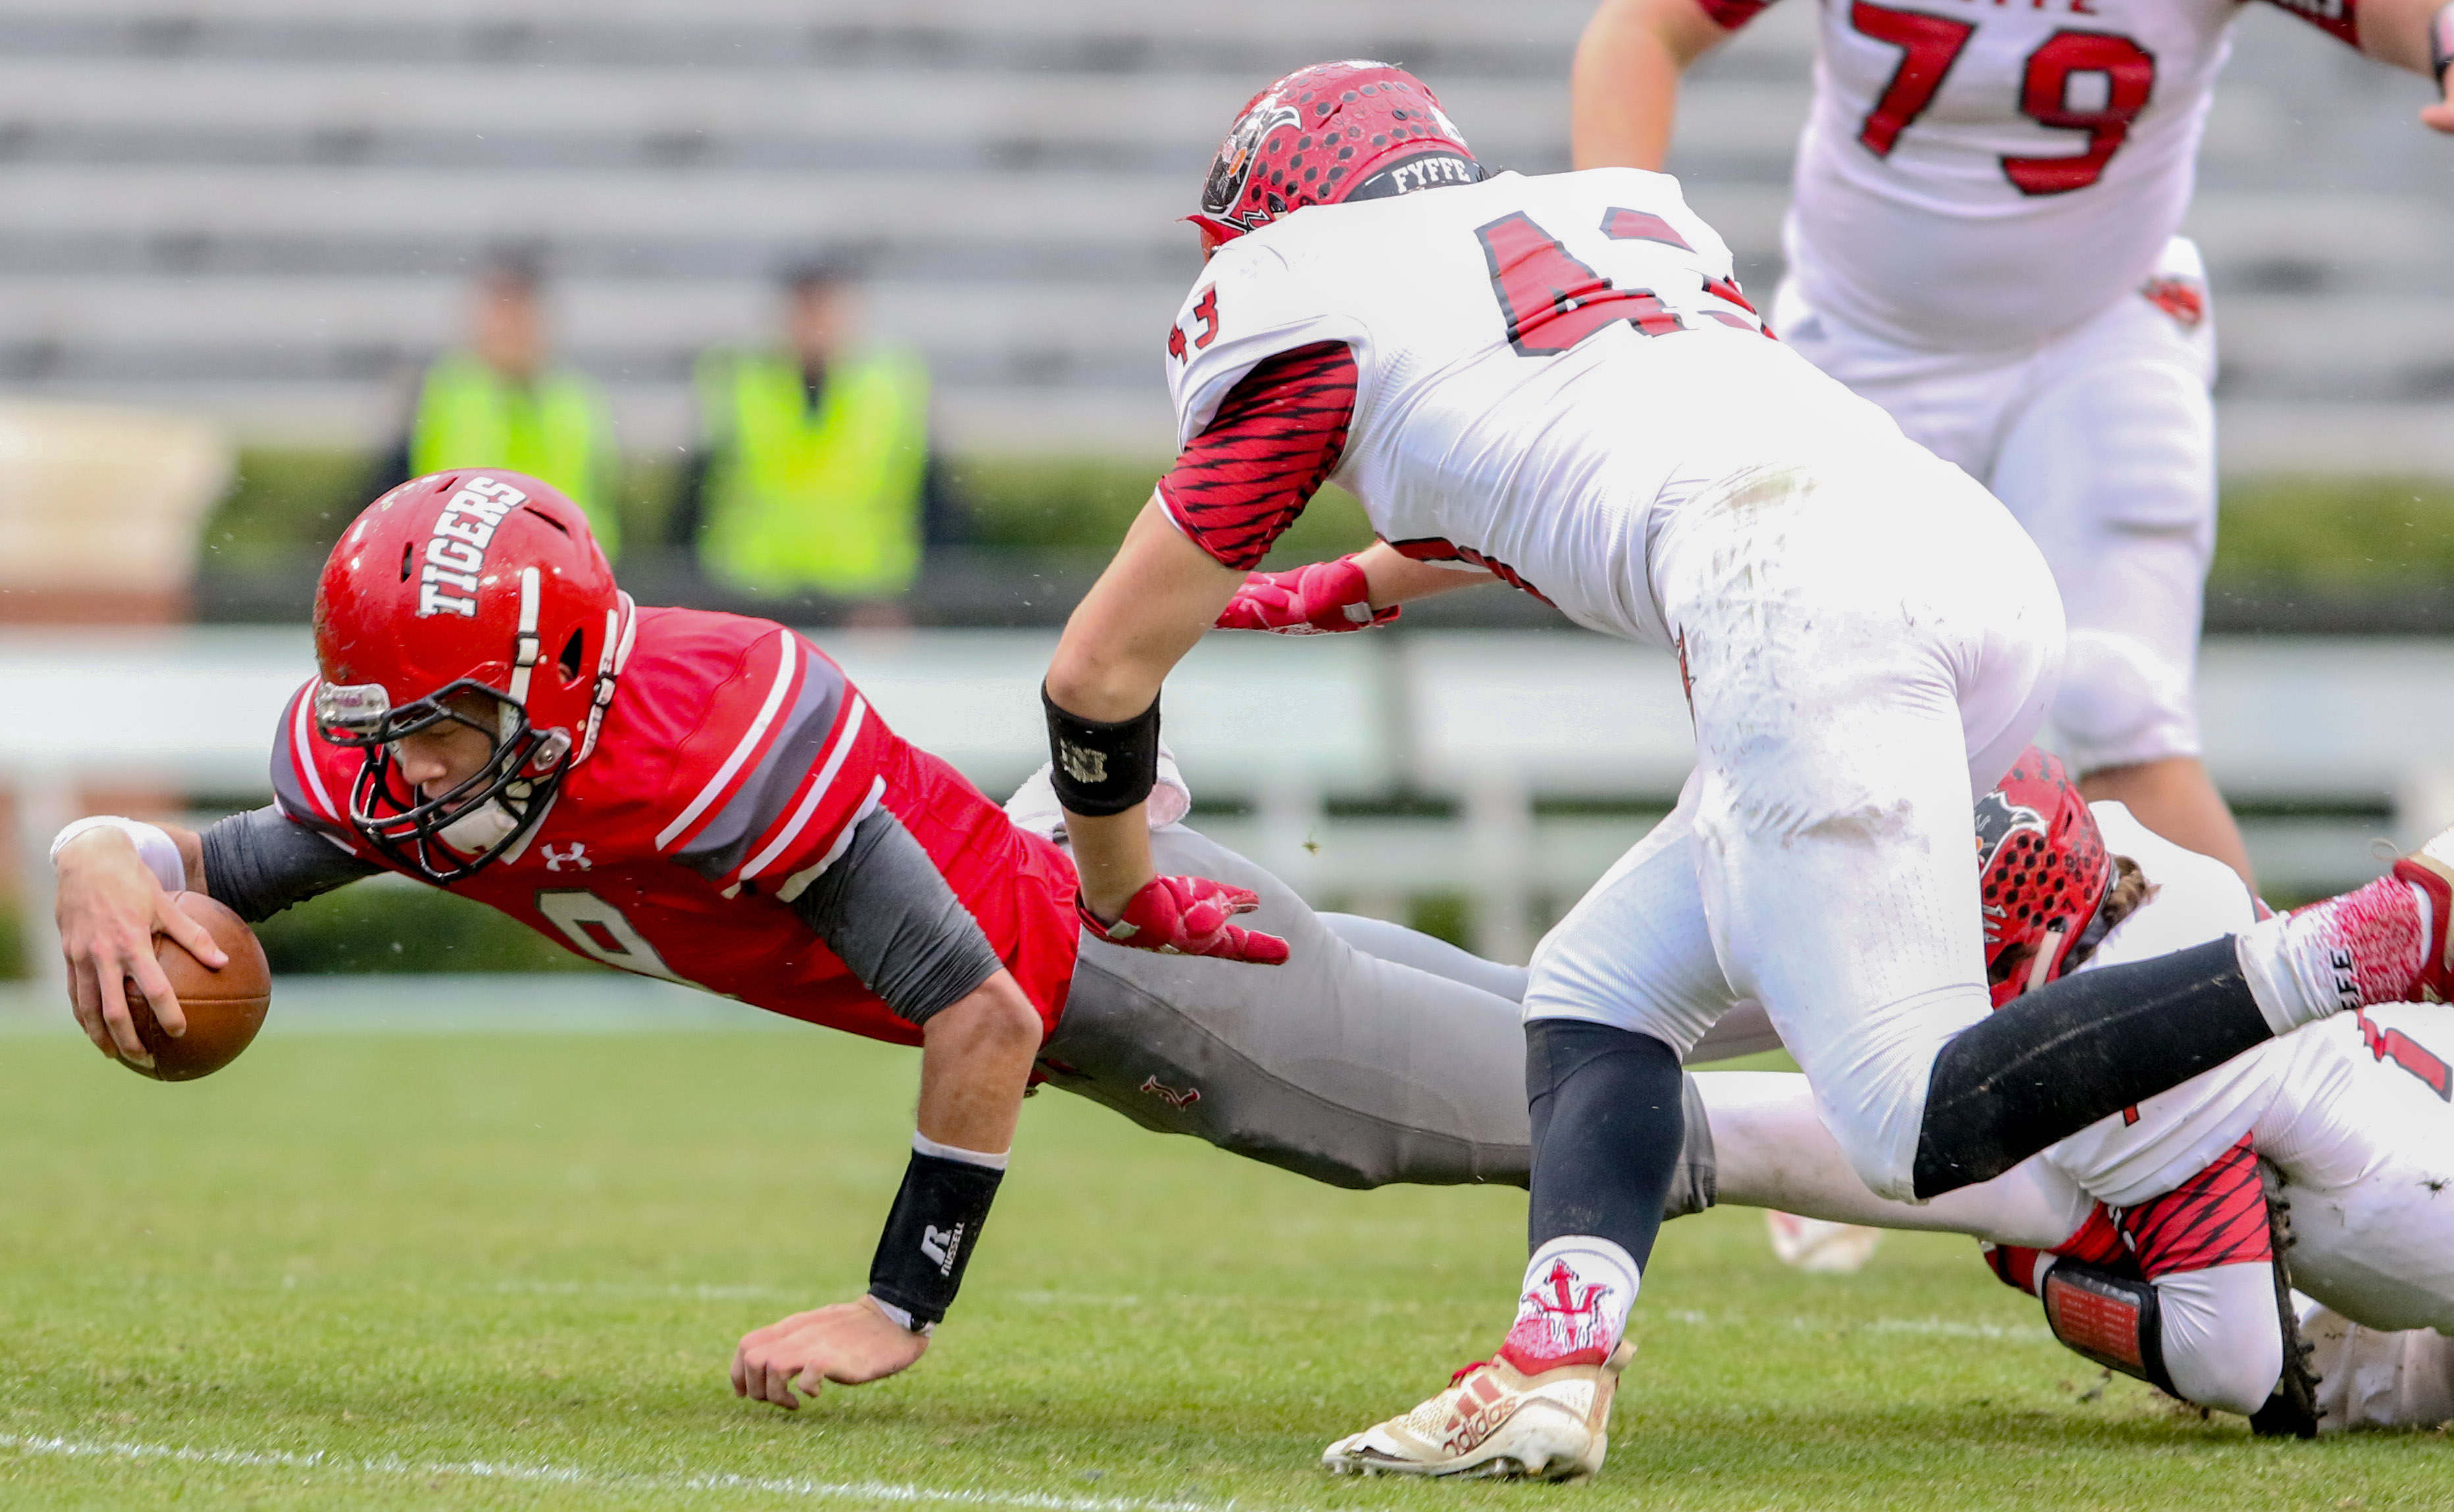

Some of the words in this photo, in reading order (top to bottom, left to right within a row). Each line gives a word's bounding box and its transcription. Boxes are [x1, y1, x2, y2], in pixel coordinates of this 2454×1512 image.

[1848, 2, 2157, 196] 79
[1392, 157, 1471, 194] FYFFE
[1168, 281, 1219, 367] 43
[419, 476, 527, 617] TIGERS
[1442, 1395, 1517, 1456] adidas
